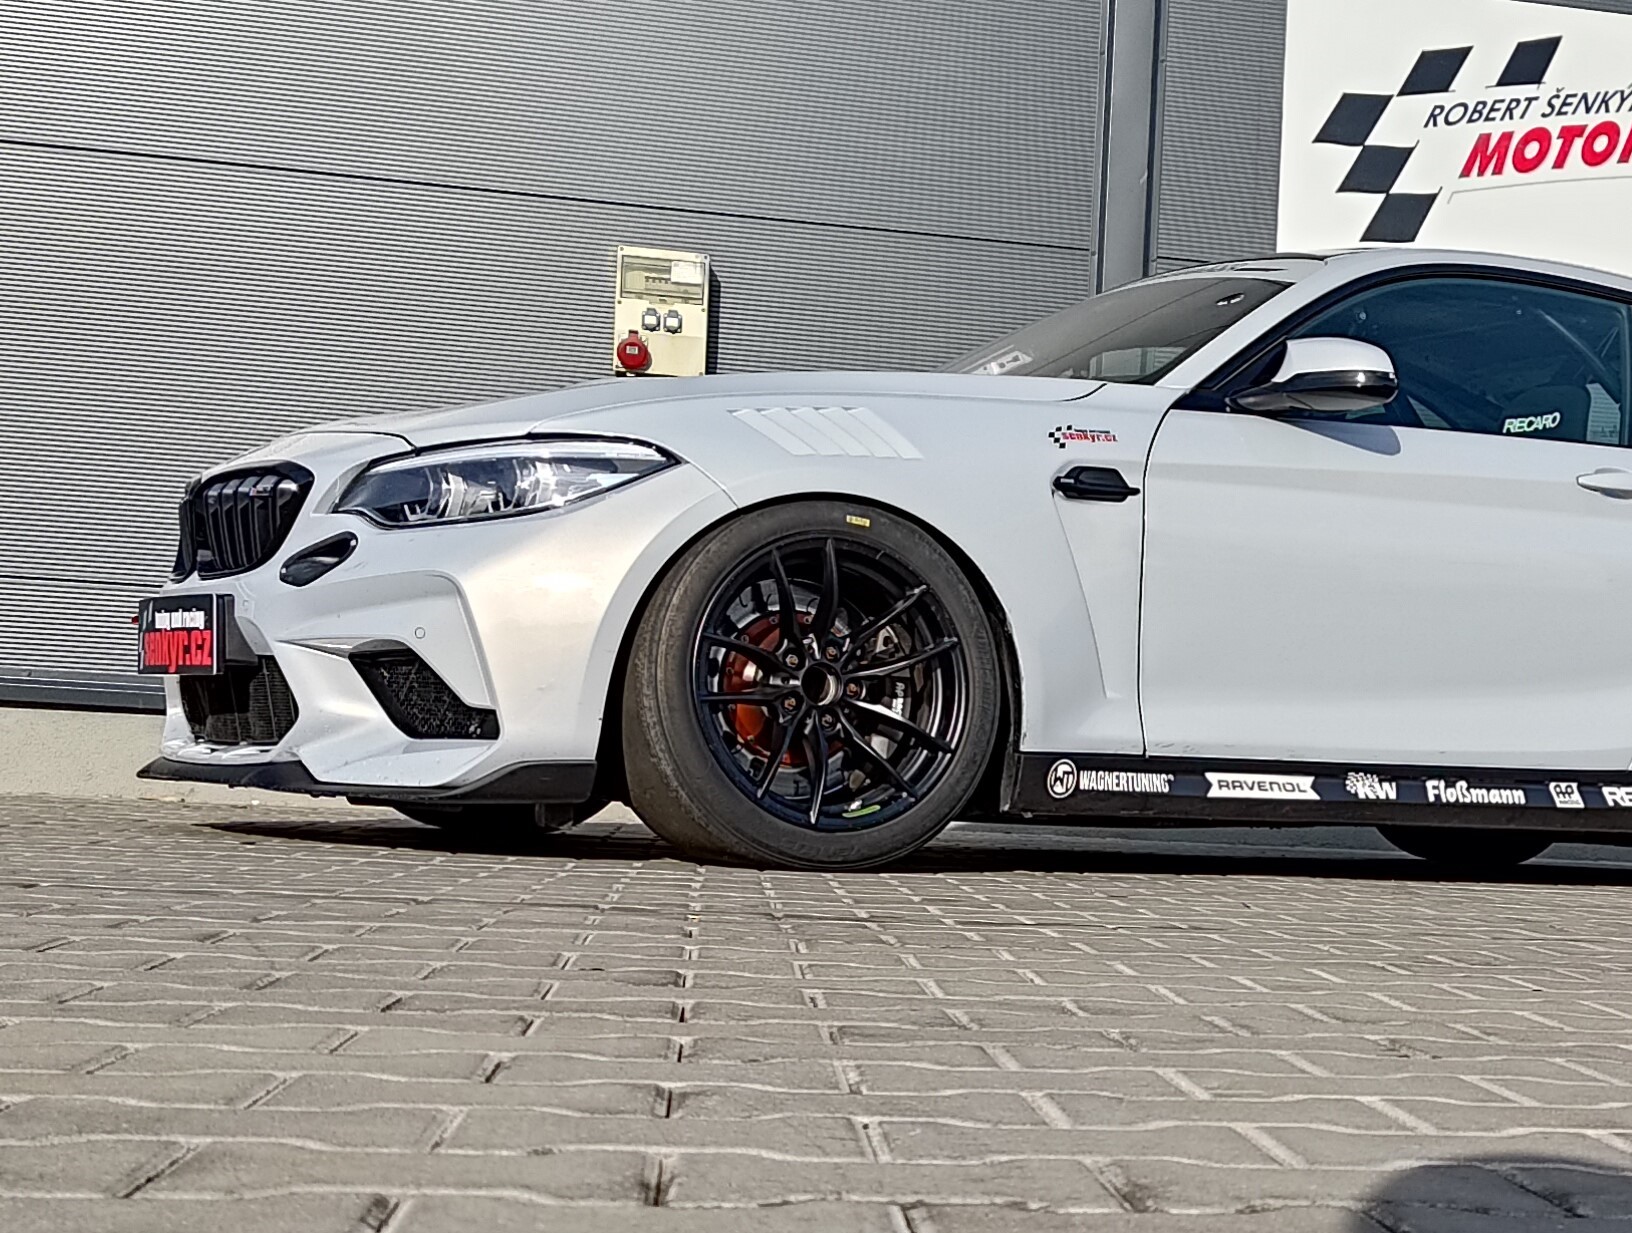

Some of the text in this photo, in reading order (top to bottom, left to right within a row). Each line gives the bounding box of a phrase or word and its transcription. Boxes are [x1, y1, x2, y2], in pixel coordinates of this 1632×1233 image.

[1423, 95, 1540, 128] ROBERT
[1502, 412, 1561, 434] RECARO
[143, 629, 212, 673] senkyr.cz
[1079, 769, 1170, 793] WAGNERTUNING
[1217, 779, 1308, 793] RAVENOL
[1356, 780, 1397, 800] KW
[1425, 779, 1526, 804] Floßmann
